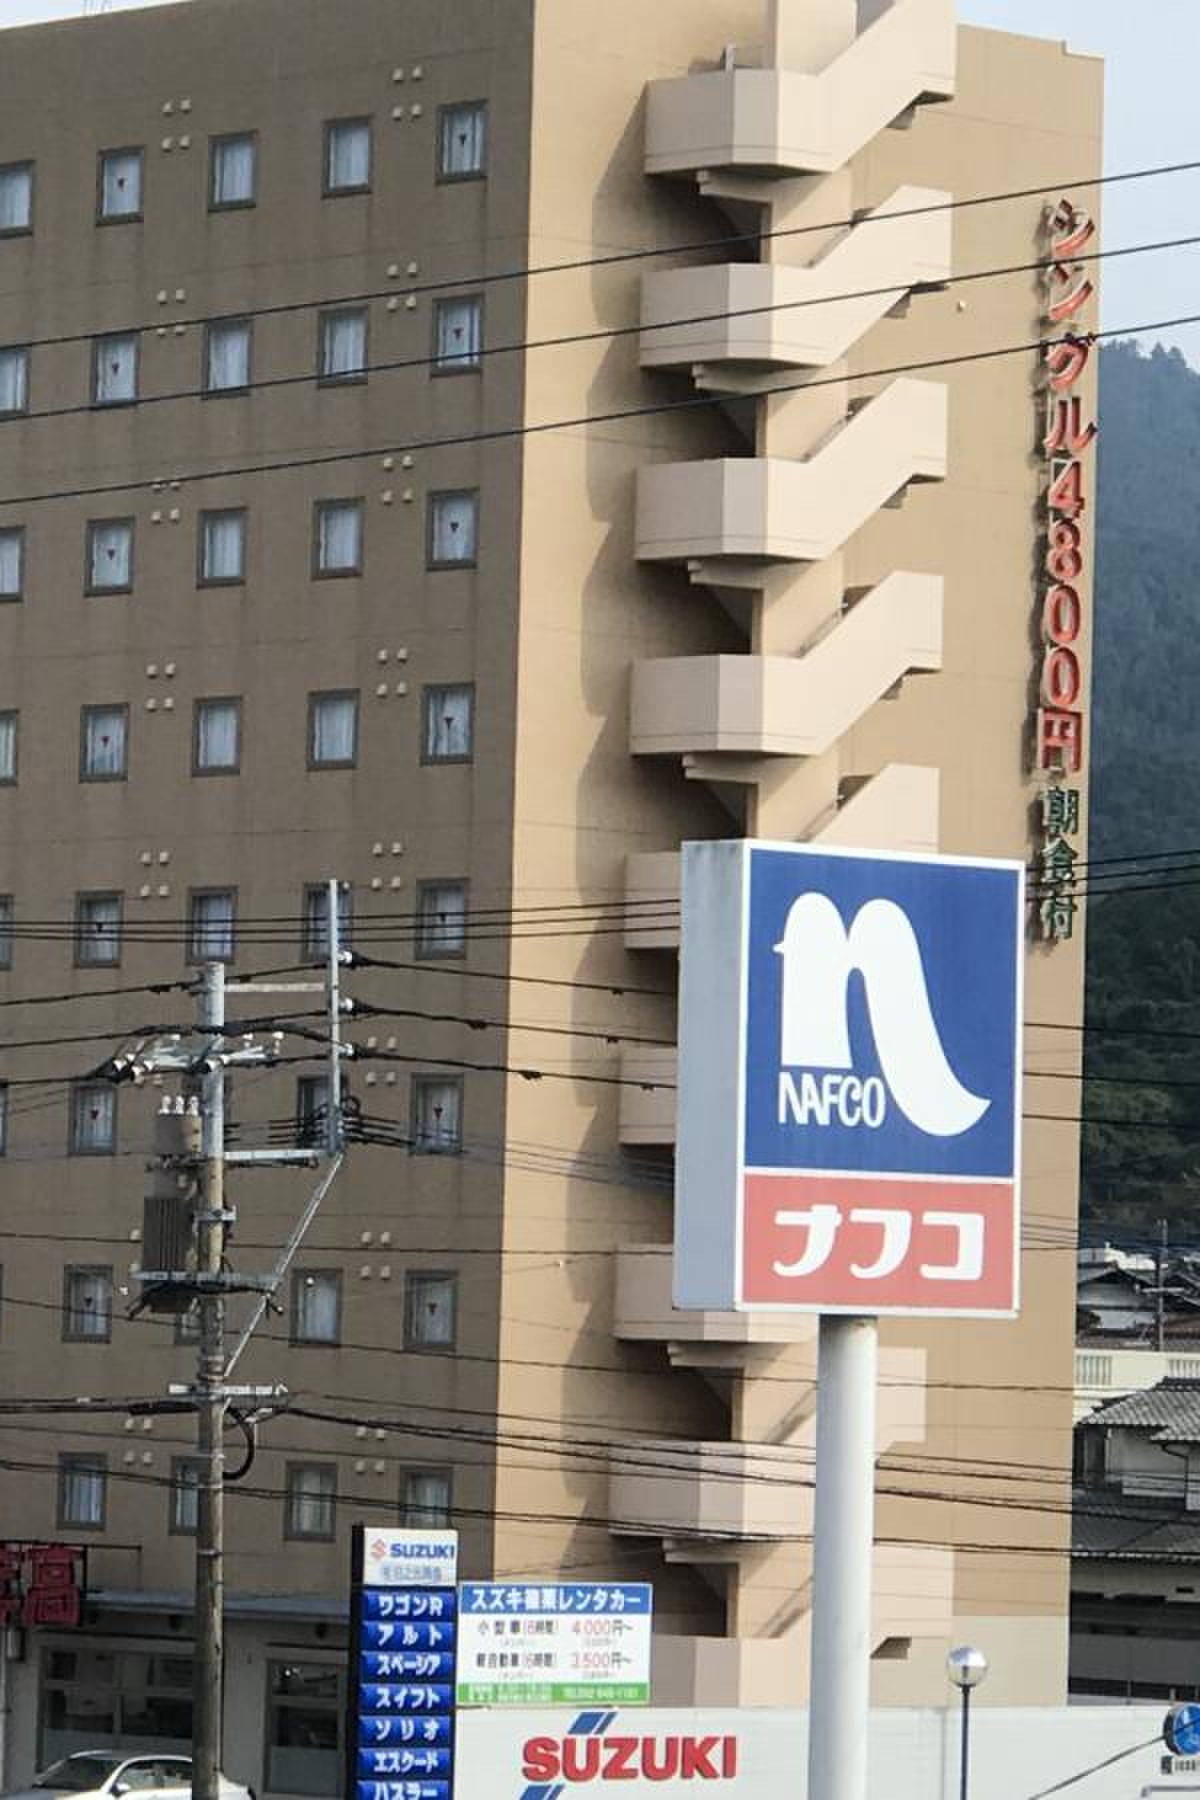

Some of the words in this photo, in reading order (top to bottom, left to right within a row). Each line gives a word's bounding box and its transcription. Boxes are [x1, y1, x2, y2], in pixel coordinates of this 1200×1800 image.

[778, 1071, 886, 1128] NAFCO
[773, 1204, 985, 1281] ナフコ
[390, 1543, 455, 1559] SUZUKI
[377, 1594, 443, 1616] ワゴンR
[377, 1623, 443, 1646] アルト
[375, 1687, 440, 1709] スイフト
[375, 1718, 440, 1740] ソリオ
[373, 1750, 439, 1773] エスクード
[522, 1736, 737, 1782] SUZUKI
[374, 1781, 439, 1800] ハスラー
